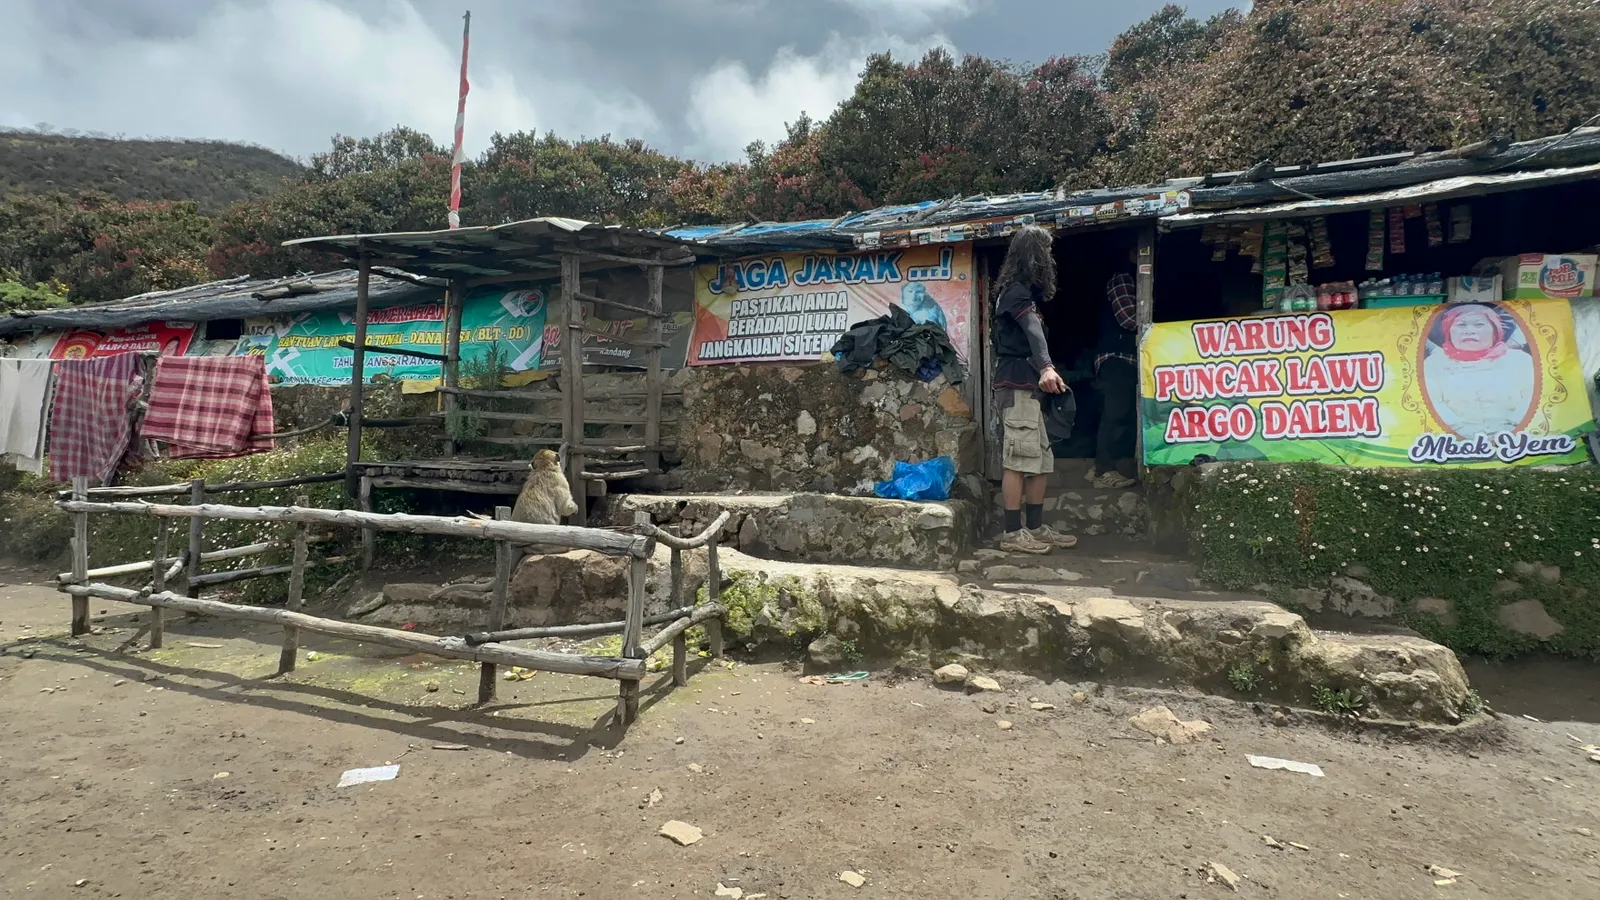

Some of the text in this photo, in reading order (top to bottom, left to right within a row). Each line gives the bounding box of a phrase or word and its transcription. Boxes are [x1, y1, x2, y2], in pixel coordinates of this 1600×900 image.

[708, 257, 789, 293] JAGA
[795, 252, 903, 284] JARAK
[1551, 271, 1577, 283] MIE
[731, 291, 848, 317] PASTIKAN ANDA
[728, 312, 847, 337] BERADA DI LUAR
[1192, 316, 1335, 357] WARUNG
[278, 336, 323, 348] BANTUAN
[375, 333, 402, 346] TUNAI
[409, 331, 442, 345] DANA
[698, 334, 842, 358] JANGKAUAN SI TEM
[1155, 352, 1383, 400] PUNCAK LAWU
[1165, 397, 1381, 442] ARGO DALEM
[1409, 431, 1573, 462] Mbok Yem
